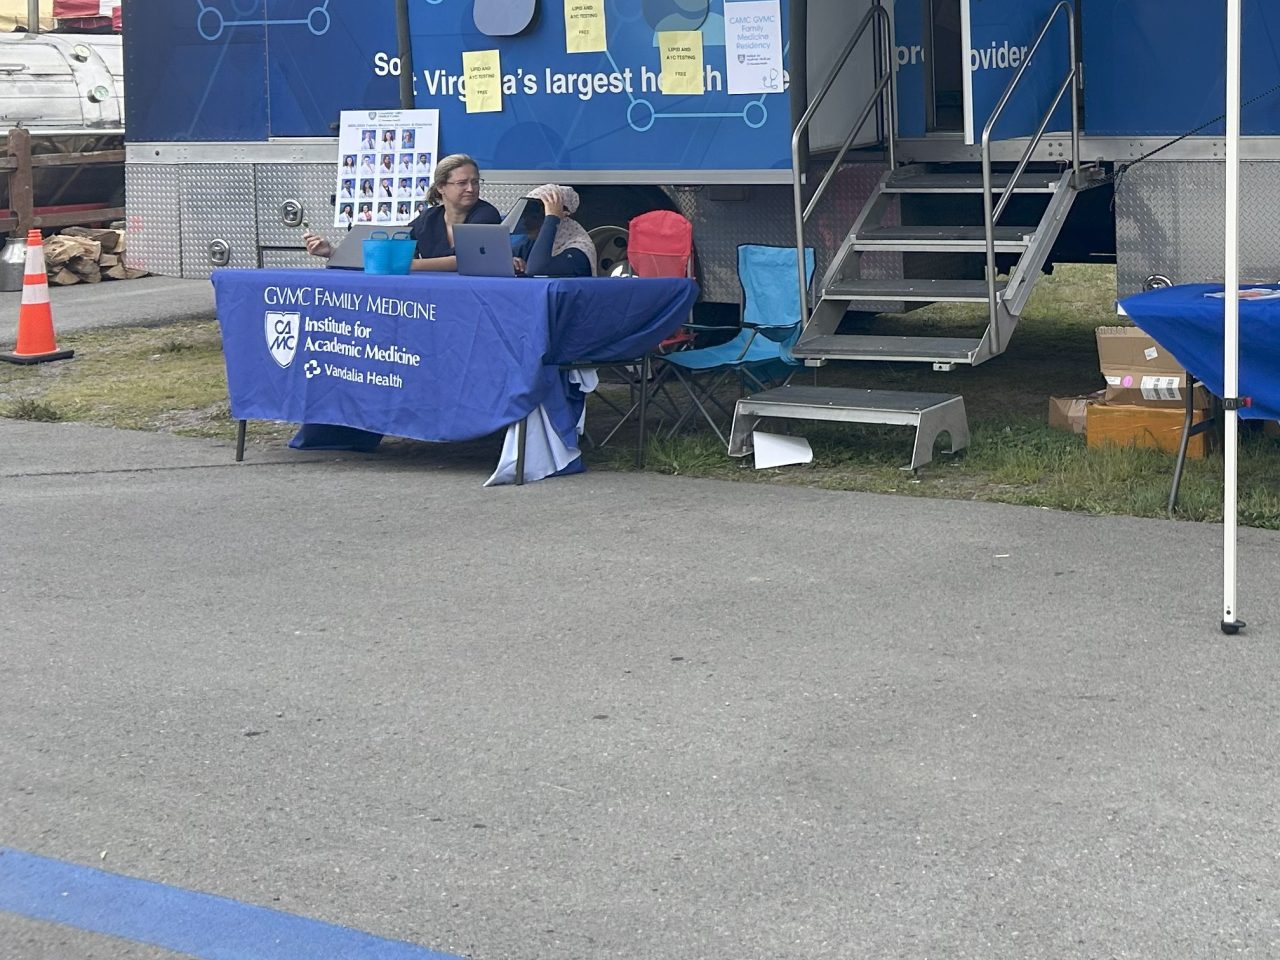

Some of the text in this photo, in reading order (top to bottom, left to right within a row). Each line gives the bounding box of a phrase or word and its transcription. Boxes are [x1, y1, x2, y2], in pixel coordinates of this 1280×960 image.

[742, 25, 764, 33] Family
[736, 42, 771, 50] Residency
[545, 68, 634, 101] largest
[264, 286, 437, 321] GVMC FAMILY MEDICINE
[304, 316, 372, 339] Institute for
[304, 337, 421, 366] Academic Medicine
[324, 363, 402, 389] Vandalia Health
